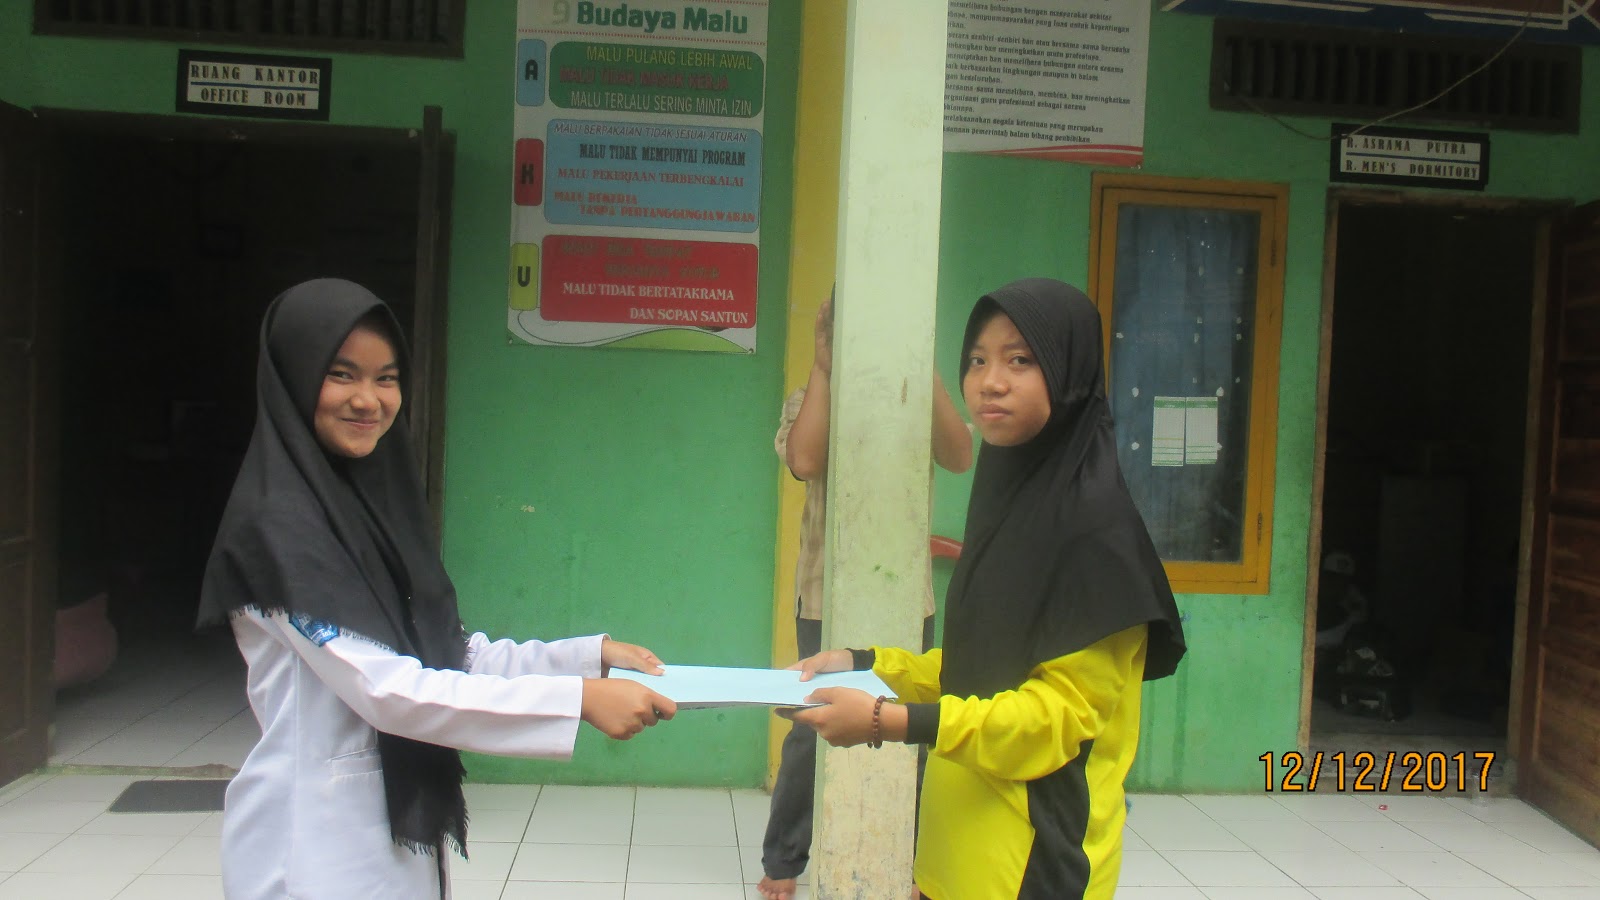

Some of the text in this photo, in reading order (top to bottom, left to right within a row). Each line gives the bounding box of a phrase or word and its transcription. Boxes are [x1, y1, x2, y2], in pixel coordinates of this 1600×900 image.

[577, 1, 676, 33] Budaya
[683, 7, 748, 34] Malu
[586, 46, 752, 70] MALU PULANG LEBIH AWAL
[191, 64, 318, 84] RUANG KANTOR
[524, 59, 538, 81] A
[201, 88, 306, 106] OFFICE ROOM
[571, 91, 751, 116] MALU TERLALU SERING MINTA IZIN
[554, 123, 748, 143] MALU BERPAKAIAN TIDAK SESUAI ATURAN
[579, 143, 746, 166] MALU TIDAK MEMPUNYAI PROGRAM
[1362, 138, 1411, 152] ASRAMA
[1427, 142, 1466, 155] PUTRA
[558, 168, 744, 187] MALU PEKERJAAN TERBENGKALAI
[1362, 161, 1396, 173] MEN'S
[1409, 163, 1477, 178] DORMITORY
[517, 266, 531, 287] U
[563, 282, 734, 301] MALU TIDAK BERTATAKRAMA
[630, 308, 748, 324] DAN SOPAN SANTUN
